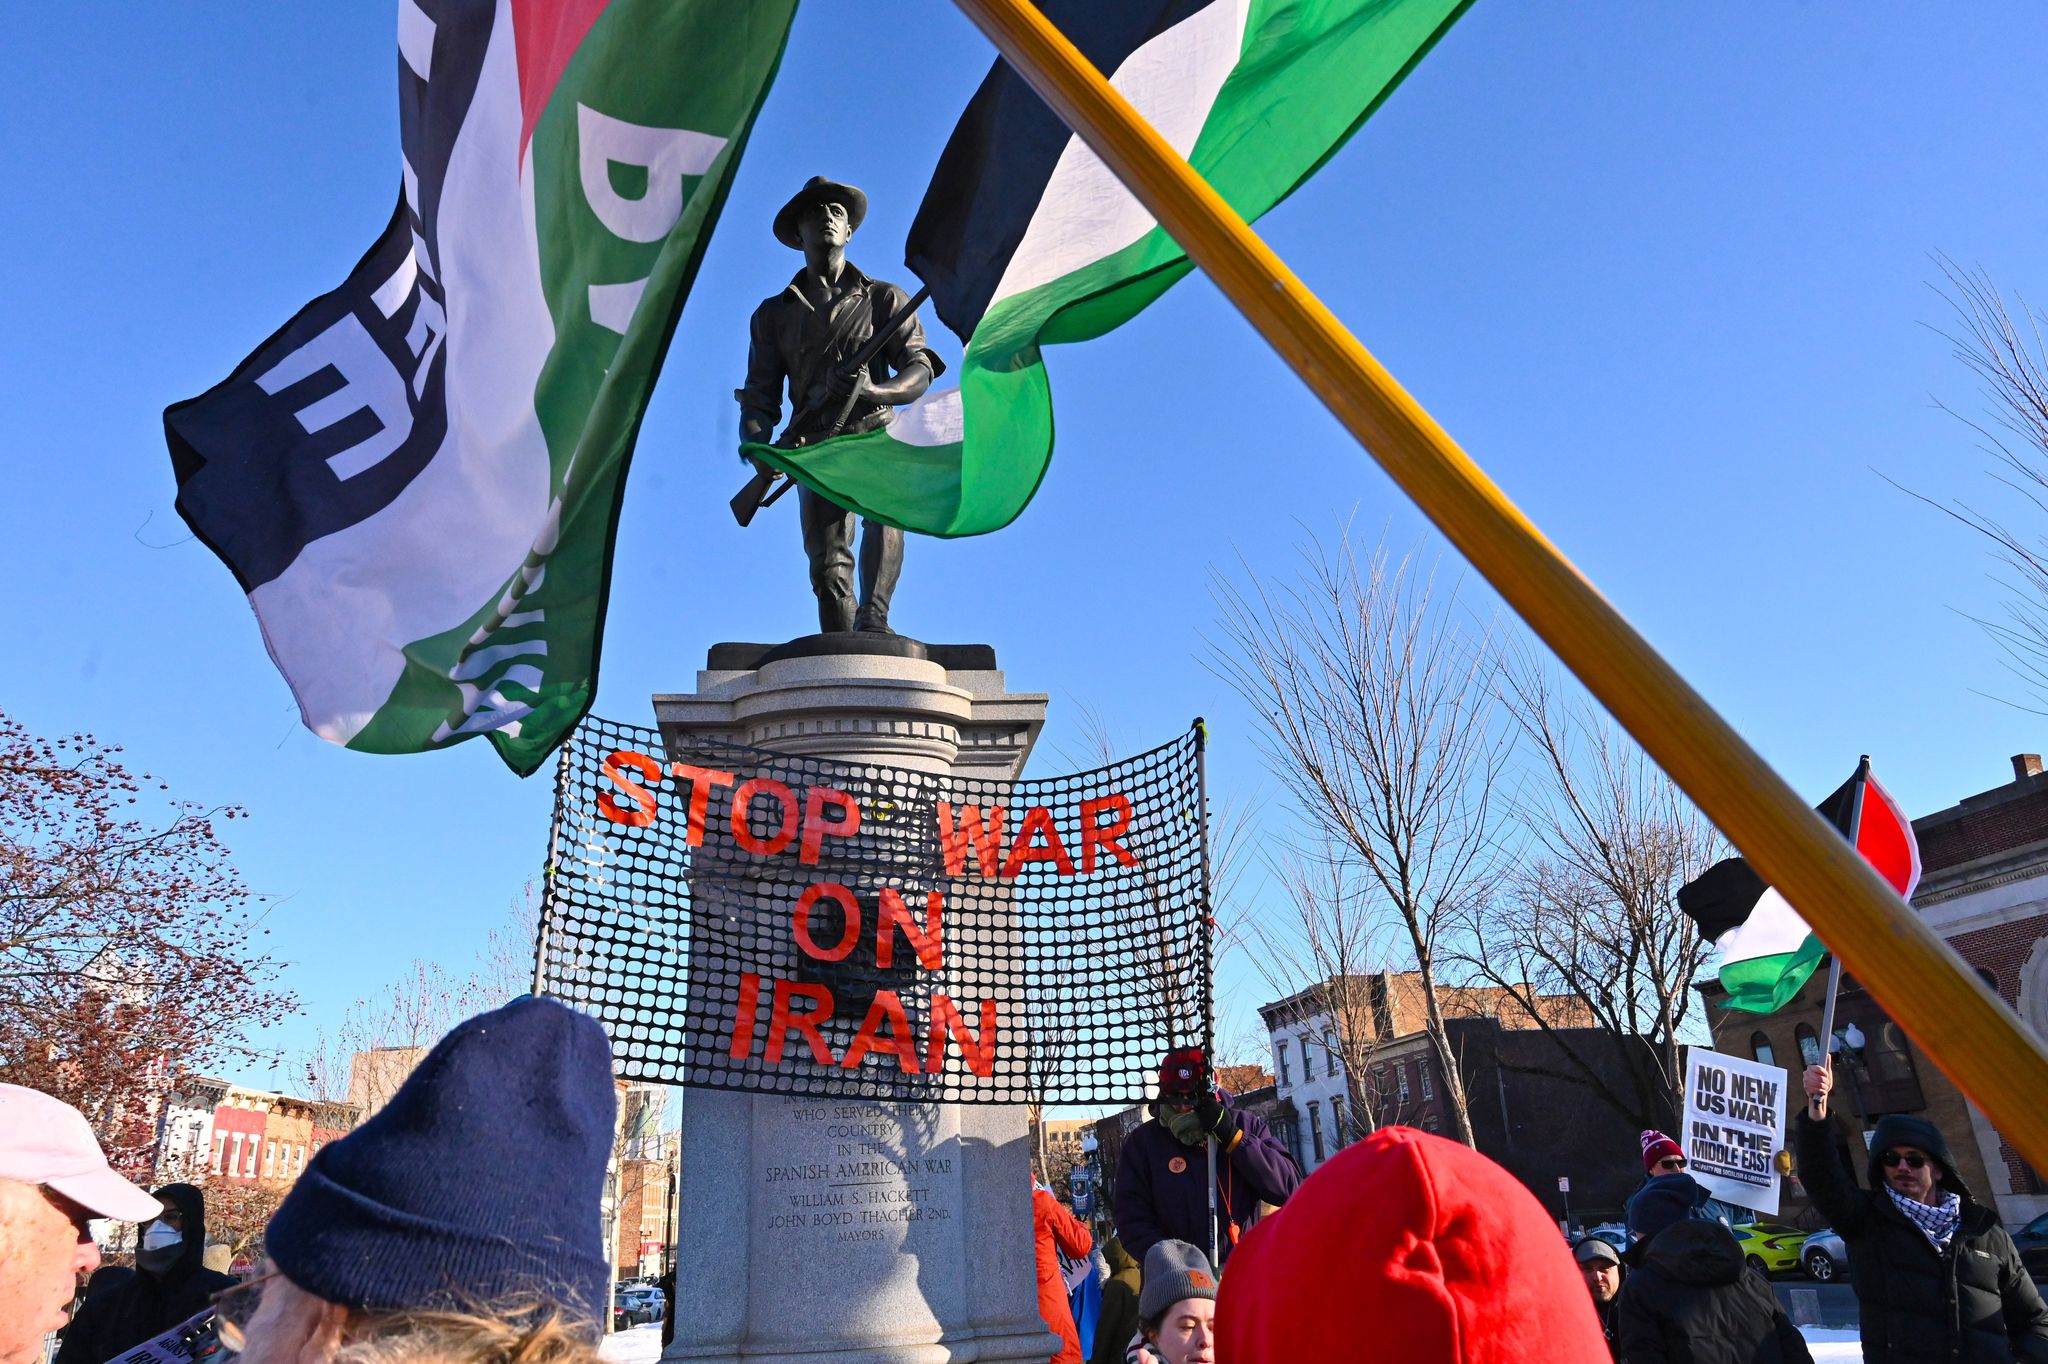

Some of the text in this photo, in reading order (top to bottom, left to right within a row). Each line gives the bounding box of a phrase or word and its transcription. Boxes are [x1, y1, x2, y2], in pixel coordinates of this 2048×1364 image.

[598, 751, 1138, 878] STOP WAR
[793, 882, 943, 970] ON
[730, 972, 996, 1078] IRAN
[1698, 1065, 1778, 1107] NO NEW
[793, 1104, 926, 1121] WHO SERVED THEIR
[1696, 1091, 1777, 1128] US WAR
[827, 1123, 896, 1139] COUNTRY
[1692, 1120, 1772, 1153] IN THE
[837, 1142, 885, 1157] IN THE
[1692, 1138, 1739, 1167] MIDDLE
[1742, 1149, 1771, 1174] EAST
[766, 1159, 952, 1182] SPANISH AMERICAN WAR
[790, 1189, 930, 1208] WILLIAM S. HACKETT
[768, 1214, 806, 1230] JOHN
[813, 1212, 853, 1226] BOYD
[860, 1209, 923, 1224] THACHER
[838, 1230, 884, 1243] MAYORS
